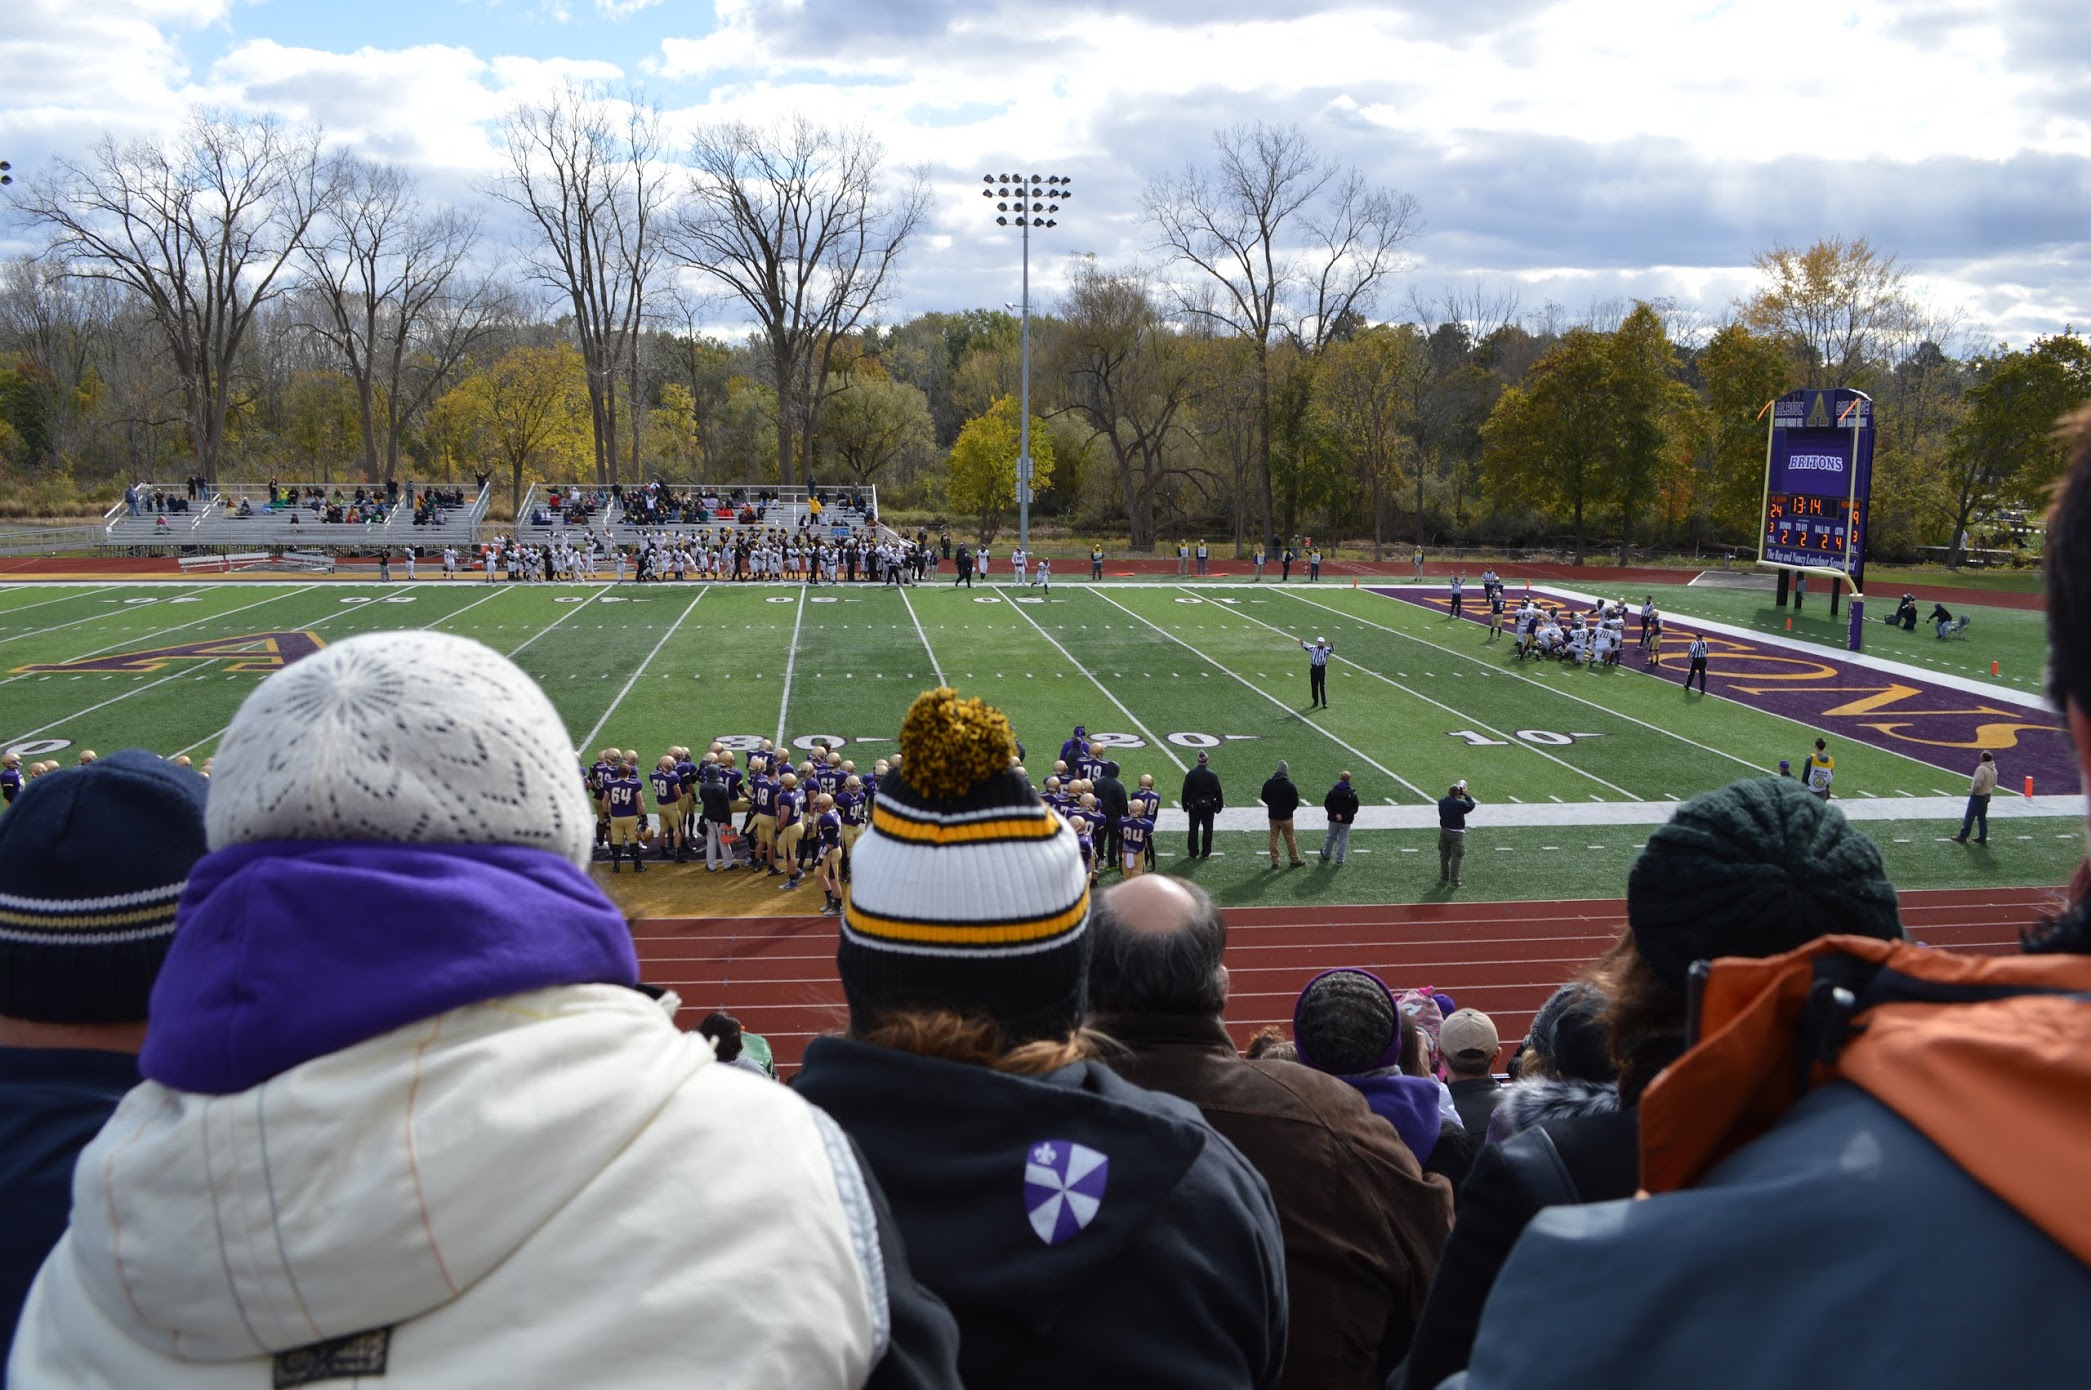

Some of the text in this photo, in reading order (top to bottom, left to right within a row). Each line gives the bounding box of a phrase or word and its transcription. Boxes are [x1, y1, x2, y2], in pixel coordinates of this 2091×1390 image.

[1775, 401, 1805, 416] ALBION
[1788, 455, 1843, 472] BRITONS
[1770, 504, 1782, 518] 24
[1782, 530, 1788, 544] 2
[1800, 531, 1807, 547] 2
[1821, 534, 1828, 549] 2
[1835, 536, 1842, 549] 4
[712, 735, 847, 750] 30
[1088, 732, 1222, 748] 20
[1447, 730, 1577, 746] 10
[1083, 764, 1102, 783] 79
[653, 780, 668, 796] 58
[820, 778, 837, 795] 52
[611, 787, 632, 805] 64
[757, 787, 769, 805] 18
